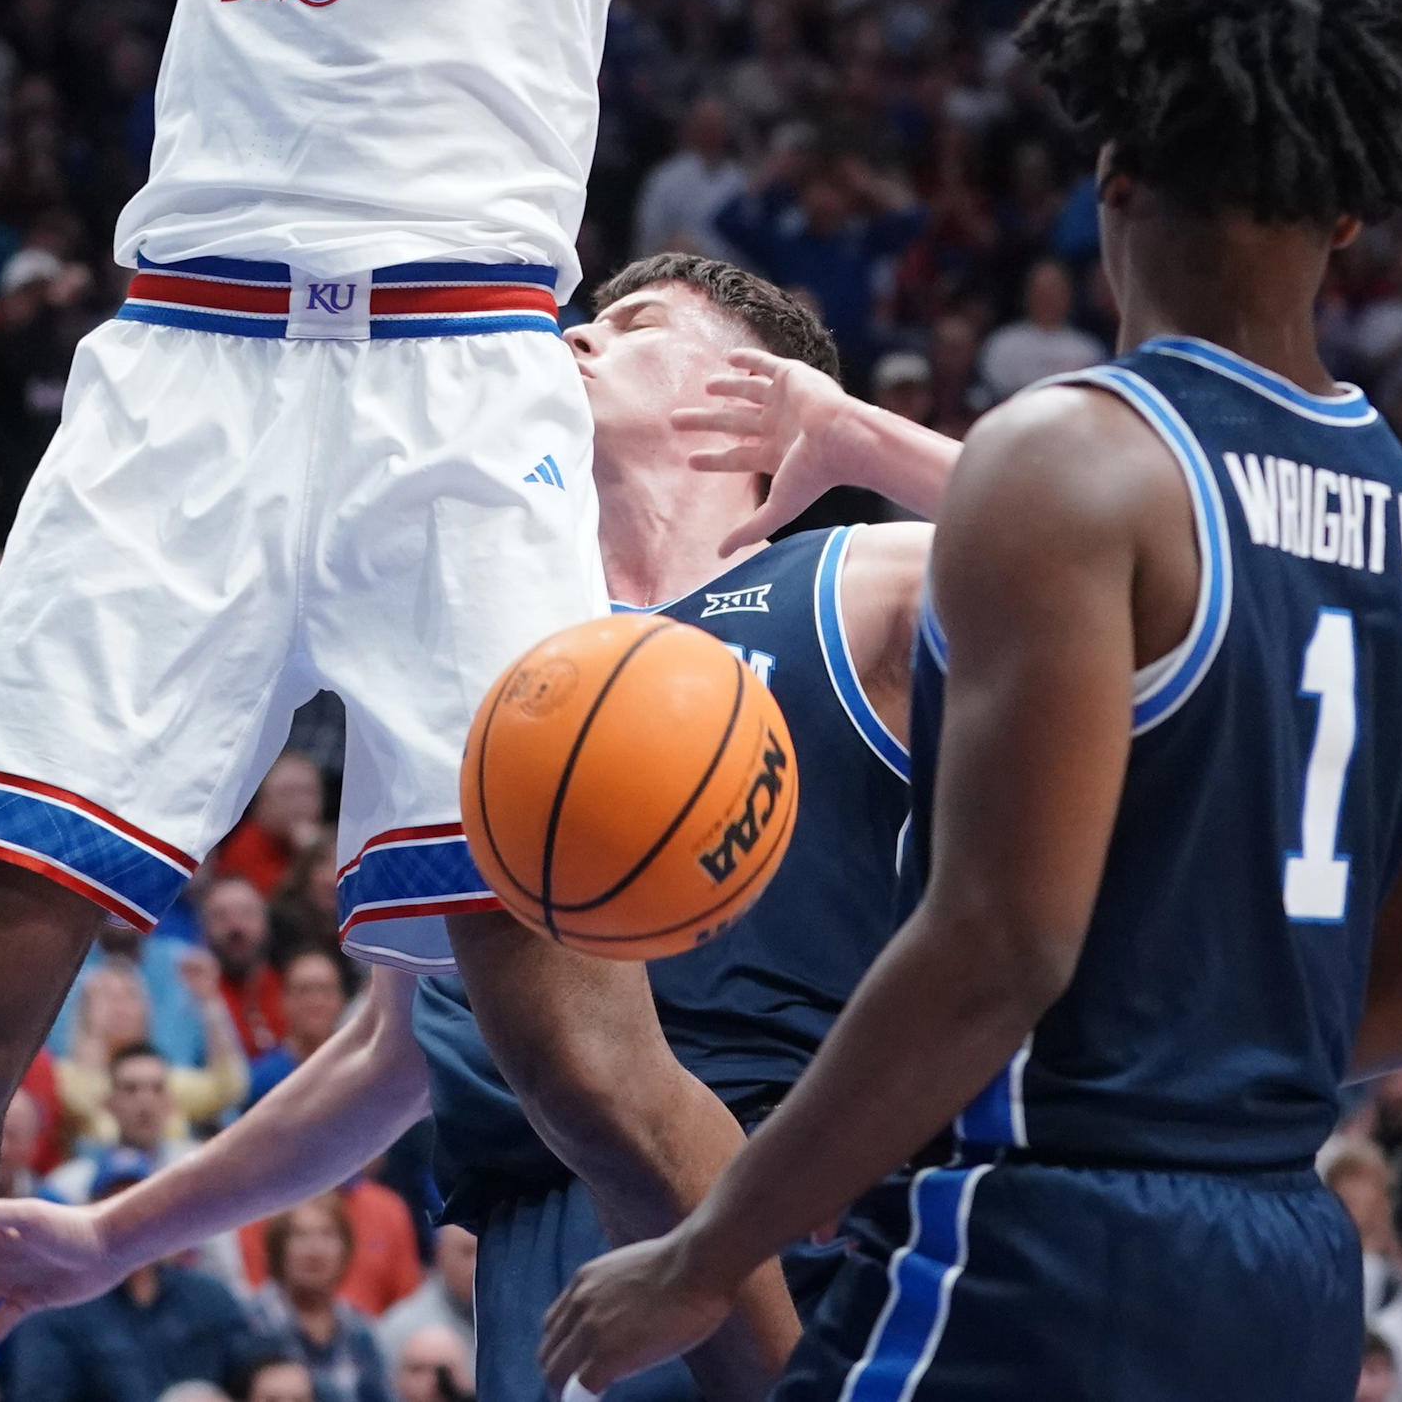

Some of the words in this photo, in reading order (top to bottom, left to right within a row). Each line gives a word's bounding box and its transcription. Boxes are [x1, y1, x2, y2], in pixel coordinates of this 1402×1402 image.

[305, 283, 357, 314] KU
[1222, 451, 1392, 574] WRIGHT
[699, 725, 788, 885] NCAA
[1282, 606, 1357, 923] 1
